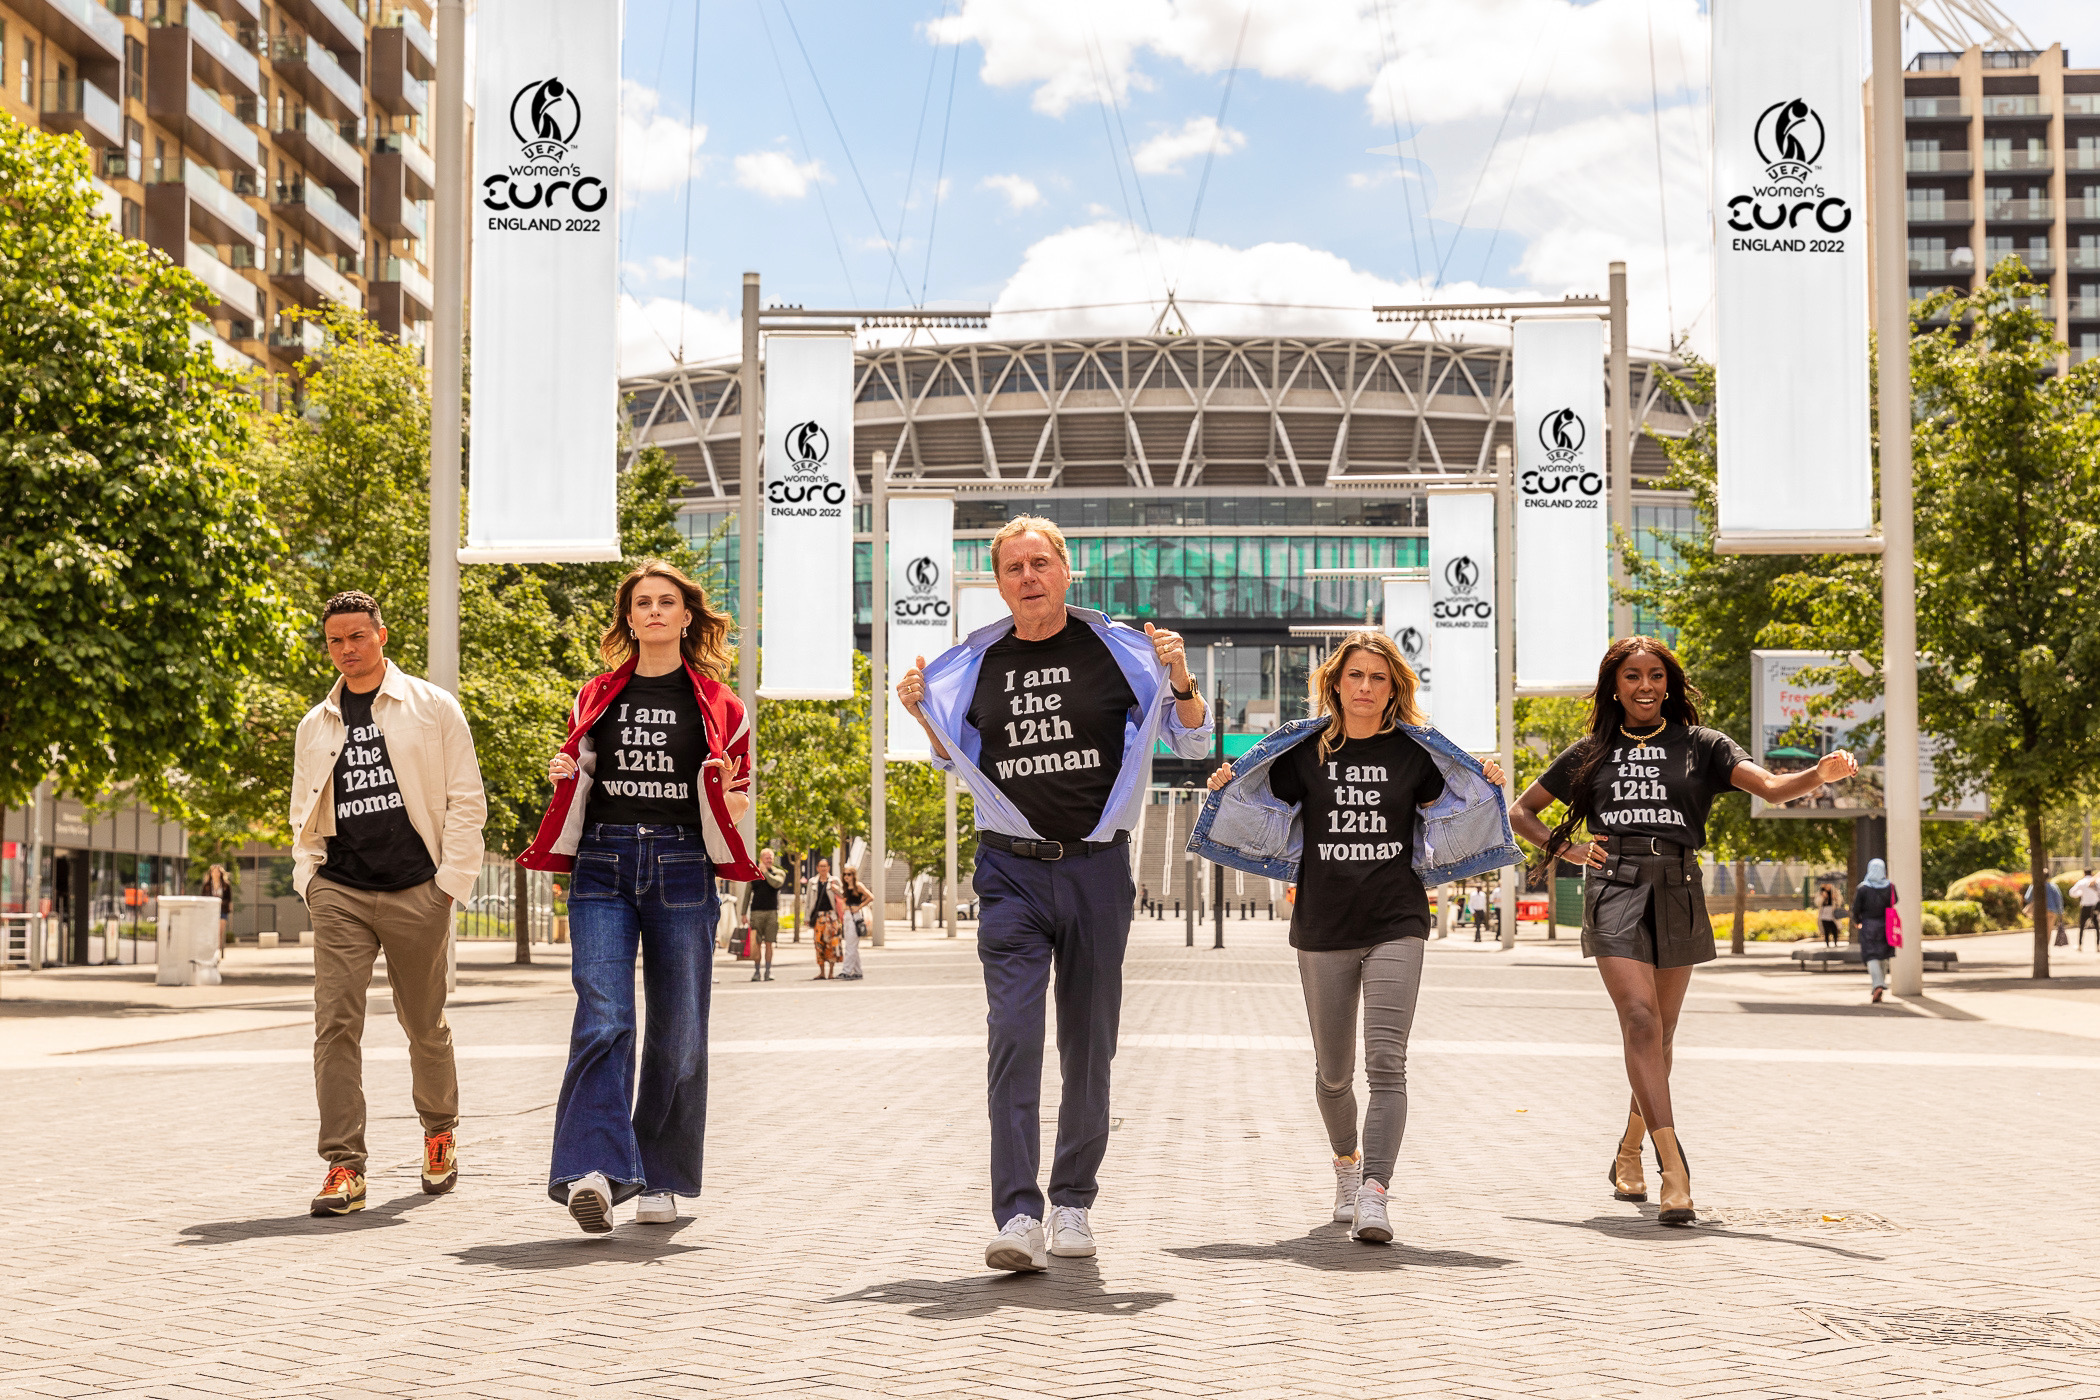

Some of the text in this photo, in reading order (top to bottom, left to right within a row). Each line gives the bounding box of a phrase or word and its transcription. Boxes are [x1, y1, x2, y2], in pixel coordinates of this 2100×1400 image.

[524, 144, 564, 160] UEFA
[509, 163, 581, 177] women's
[1768, 165, 1808, 181] UEFA
[1753, 184, 1825, 197] women's
[488, 217, 601, 231] ENGLAND 2022
[1732, 238, 1844, 252] ENGLAND 2022
[1547, 451, 1574, 462] UEFA
[793, 462, 819, 473] UEFA
[1538, 463, 1586, 473] women's
[784, 474, 829, 482] women's
[771, 507, 842, 517] ENGLAND 2022
[1524, 498, 1598, 509] ENGLAND 2022
[896, 618, 948, 627] ENGLAND 2022
[1435, 621, 1489, 629] ENGLAND 2022
[1004, 666, 1071, 692] I am
[617, 703, 677, 724] I am
[1010, 692, 1062, 716] the
[620, 727, 667, 746] the
[1004, 715, 1074, 747] 12th
[345, 746, 382, 766] the
[614, 749, 675, 772] 12th
[996, 748, 1101, 780] woman
[1611, 746, 1667, 763] I am
[342, 765, 395, 792] 12th
[1327, 761, 1388, 782] I am
[1617, 762, 1660, 778] the
[602, 780, 689, 799] woman
[1334, 785, 1381, 805] the
[1610, 780, 1667, 801] 12th
[338, 792, 404, 819] woma
[1328, 810, 1387, 833] 12th
[1600, 808, 1687, 827] woman
[1318, 841, 1403, 861] woman
